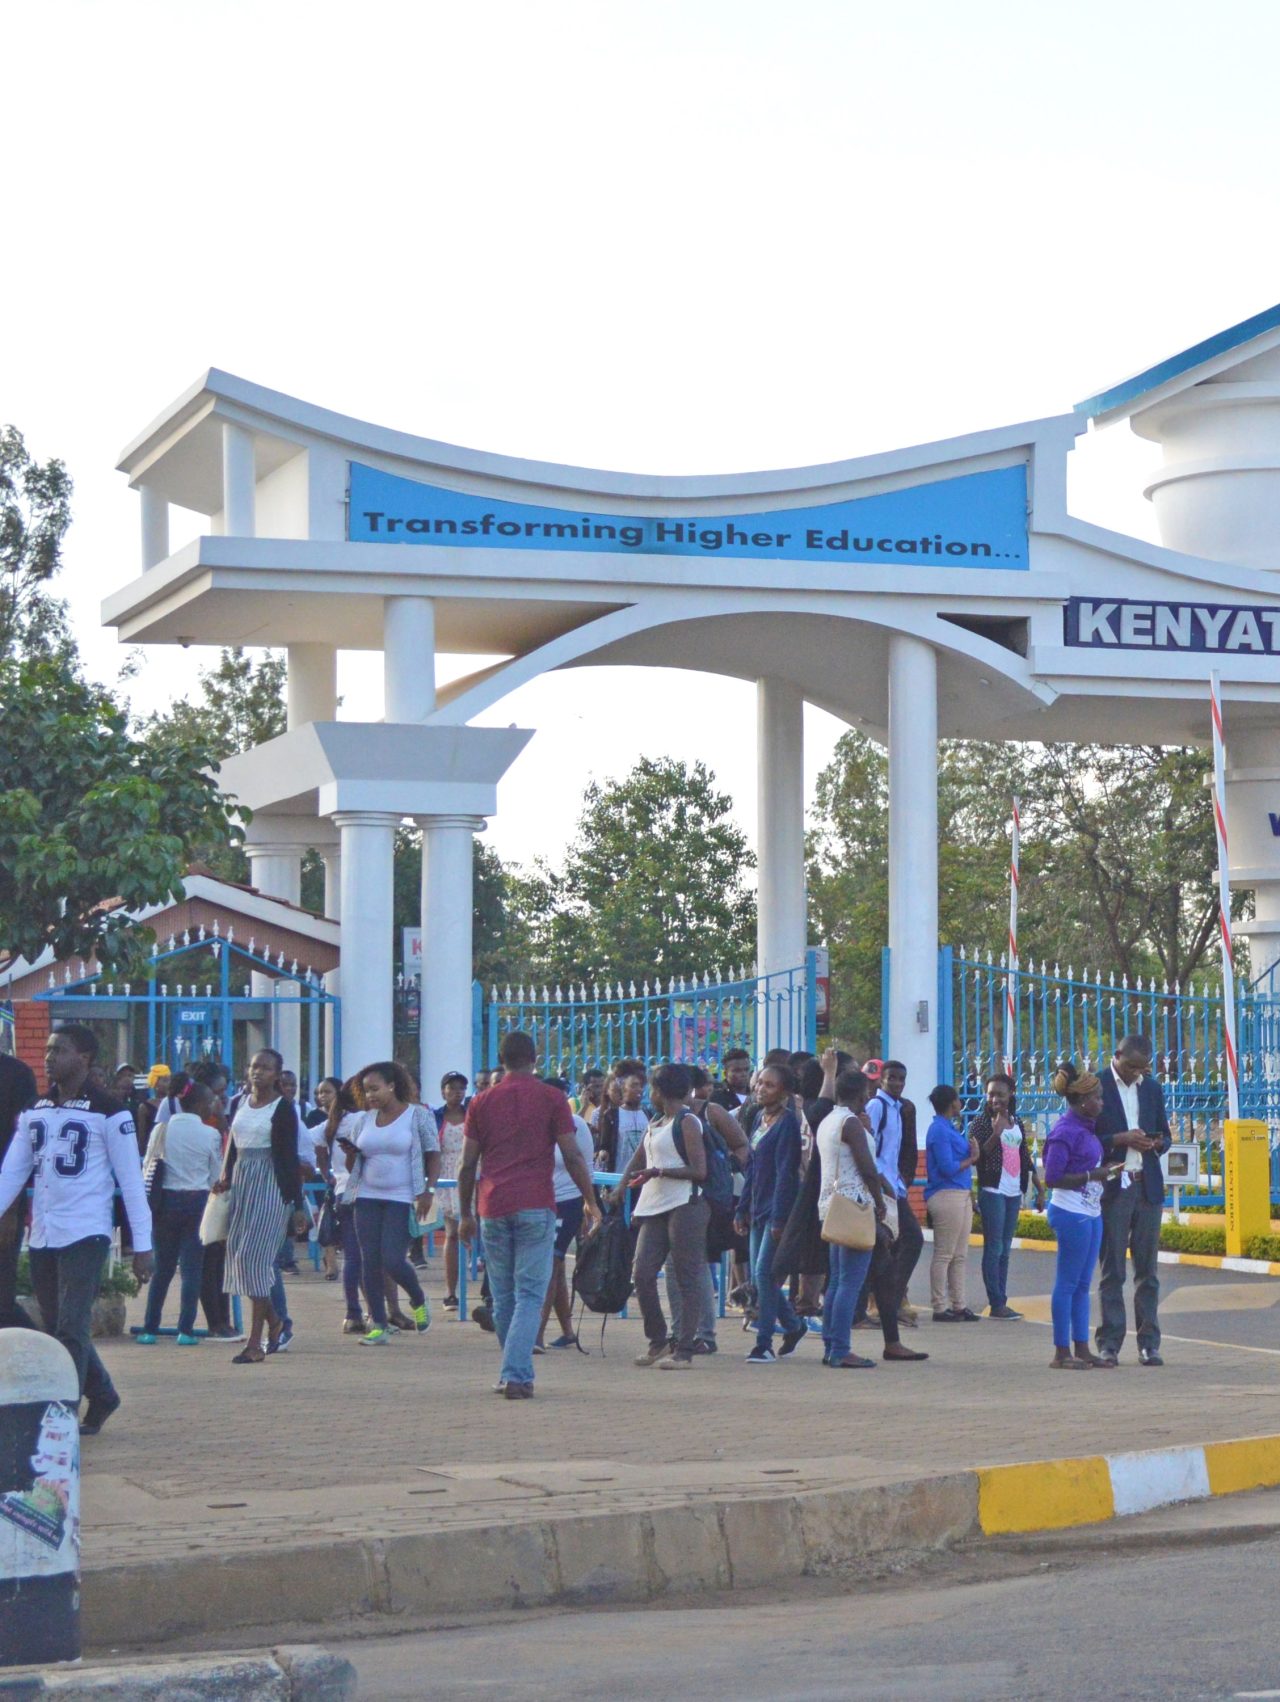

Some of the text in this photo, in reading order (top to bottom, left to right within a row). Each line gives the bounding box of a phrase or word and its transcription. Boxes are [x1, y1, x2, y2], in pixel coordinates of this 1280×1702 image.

[363, 512, 643, 547] Transforming
[656, 522, 792, 550] Higher
[181, 1011, 206, 1021] EXIT
